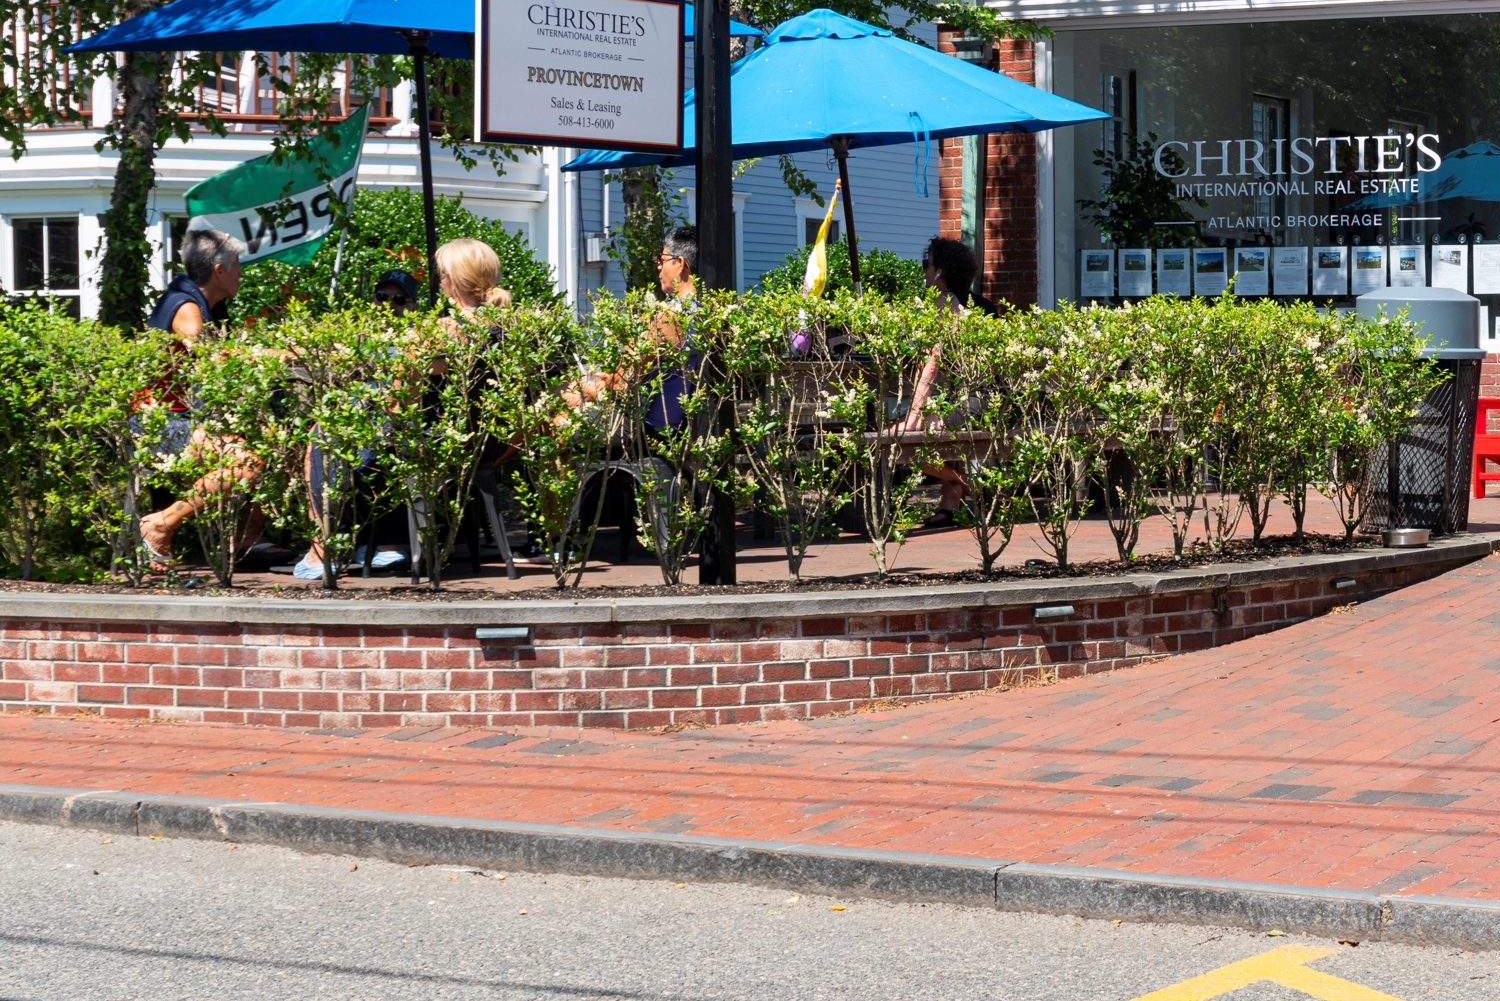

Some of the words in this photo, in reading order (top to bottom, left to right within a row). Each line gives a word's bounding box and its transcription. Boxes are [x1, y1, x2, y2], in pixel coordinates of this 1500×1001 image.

[527, 4, 645, 36] CHRISTIE'S
[536, 28, 593, 42] INTERNATIONAL
[595, 34, 612, 44] REAL
[613, 36, 636, 46] ESTATE
[550, 48, 581, 57] ATLANTIC
[584, 51, 622, 61] BROKERAGE
[527, 66, 644, 93] PROVINCETOWN
[550, 96, 574, 110] Sales
[576, 99, 585, 111] &
[587, 100, 622, 116] Leasing
[558, 115, 614, 130] 508-413-6000
[1153, 133, 1441, 178] CHRISTIE'S
[1176, 181, 1309, 198] INTERNATIONAL
[1315, 179, 1355, 195] REAL
[1361, 178, 1419, 194] ESTATE
[1208, 216, 1281, 228] ATLANTIC
[1287, 214, 1382, 227] BROKERAGE
